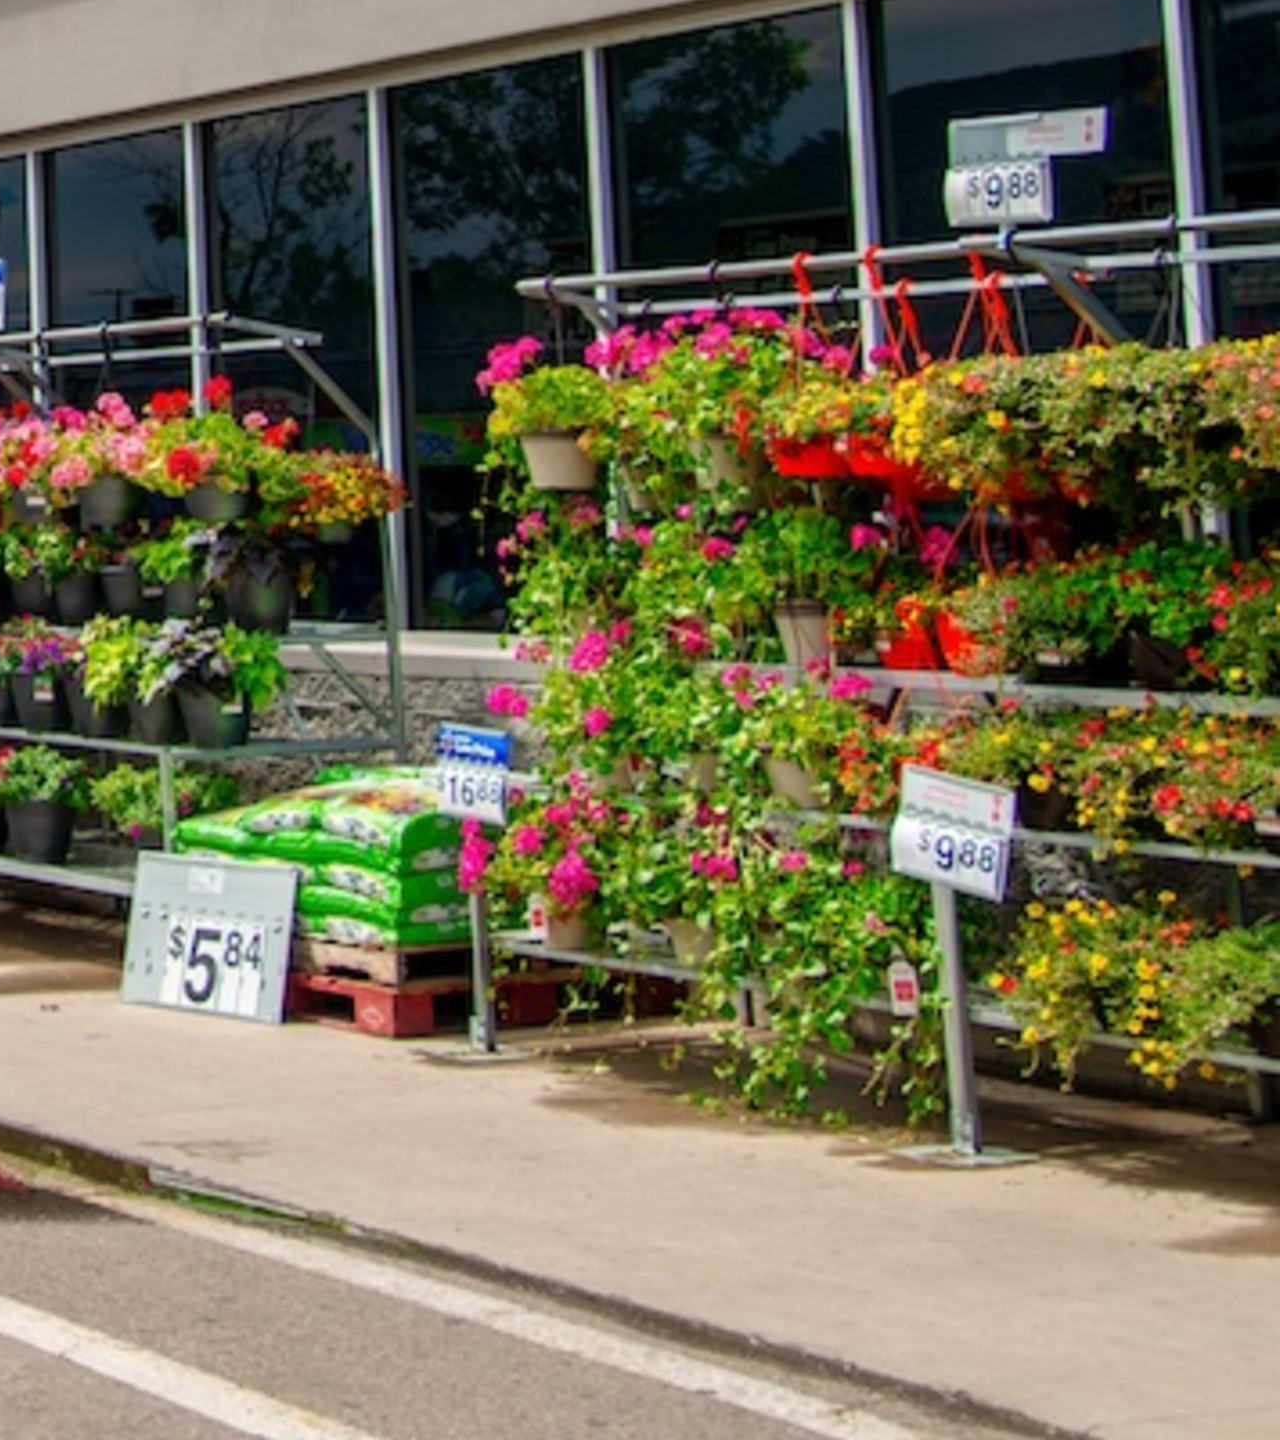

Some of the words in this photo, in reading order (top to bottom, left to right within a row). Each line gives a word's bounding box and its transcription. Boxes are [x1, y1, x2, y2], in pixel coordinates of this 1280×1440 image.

[967, 171, 1040, 209] $988
[916, 829, 997, 873] $988
[169, 925, 262, 1004] $584
